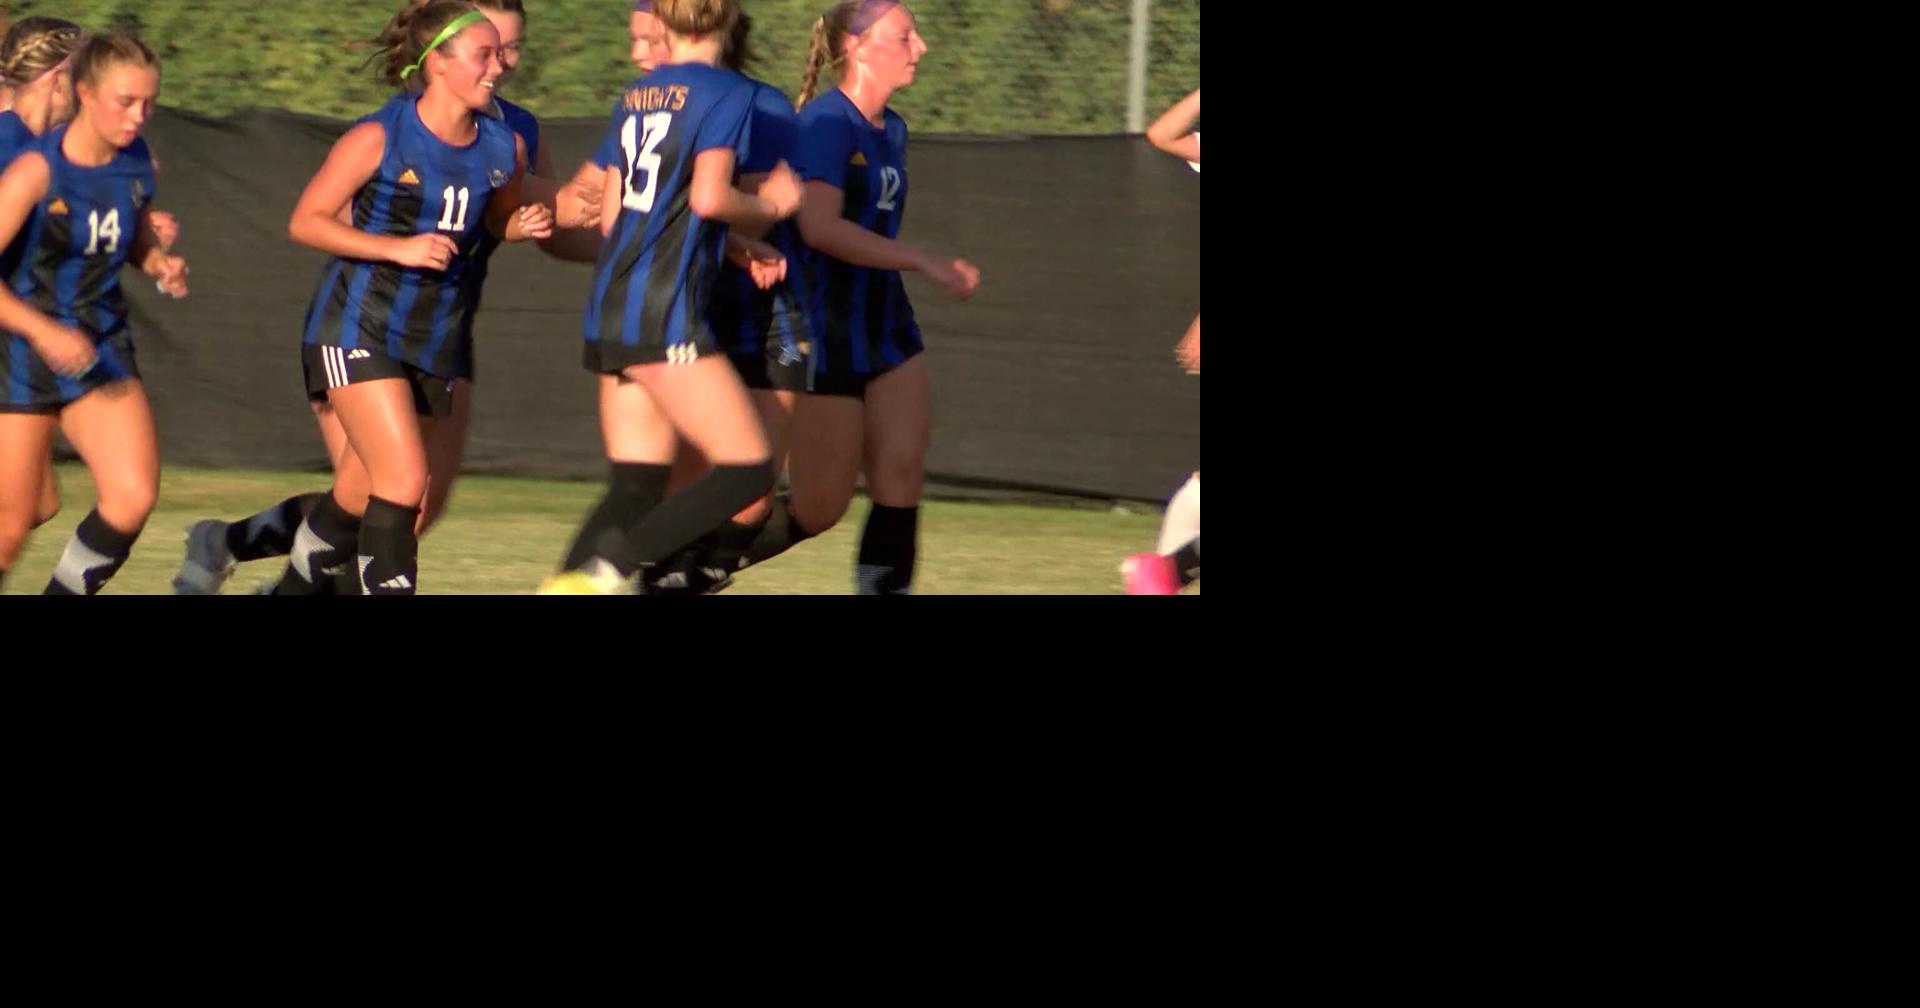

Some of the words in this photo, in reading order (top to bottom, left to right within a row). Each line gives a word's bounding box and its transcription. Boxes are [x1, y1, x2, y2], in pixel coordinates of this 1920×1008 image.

[621, 111, 672, 213] 13
[438, 185, 469, 231] 11
[876, 166, 900, 210] 12
[84, 208, 121, 255] 14
